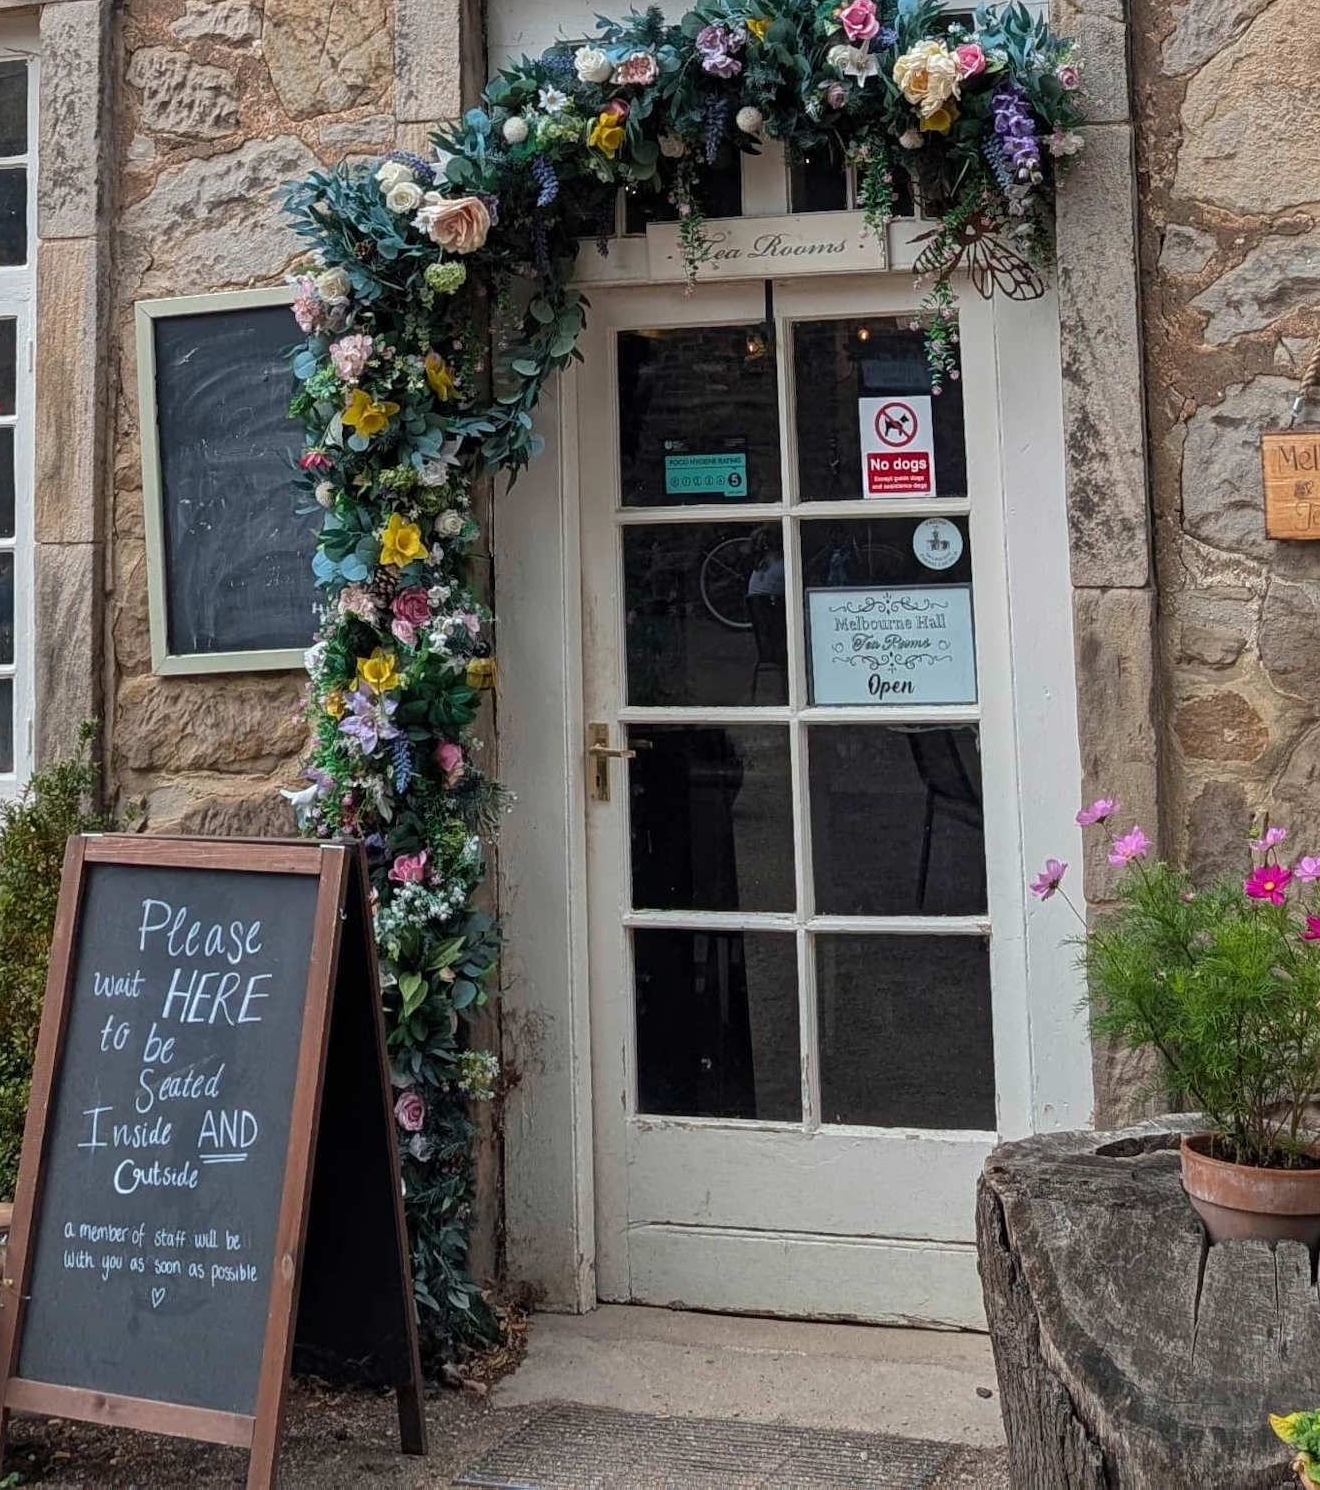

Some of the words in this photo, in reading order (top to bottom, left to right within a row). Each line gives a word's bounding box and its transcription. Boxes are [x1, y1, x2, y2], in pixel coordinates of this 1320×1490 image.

[696, 232, 742, 261] Tea
[747, 232, 848, 259] Rooms
[729, 473, 740, 486] 5
[870, 458, 890, 471] No
[893, 456, 927, 473] dogs
[835, 615, 912, 631] Melbourne
[916, 613, 946, 629] Hall
[852, 633, 880, 651] Tea
[882, 634, 932, 651] Rooms
[868, 673, 916, 700] Open
[138, 898, 262, 964] Please
[162, 968, 272, 1026] HERE
[100, 1014, 131, 1052] to
[143, 1022, 175, 1063] be
[135, 1063, 226, 1113] Seated
[77, 1106, 172, 1150] Inside
[197, 1110, 258, 1148] AND
[113, 1159, 198, 1194] Outside
[64, 1221, 76, 1238] a
[79, 1222, 128, 1243] member
[131, 1222, 145, 1248] of
[154, 1228, 186, 1248] staff
[194, 1229, 218, 1248] will
[225, 1231, 241, 1250] be
[101, 1254, 123, 1281] you
[129, 1256, 145, 1273] as
[154, 1257, 181, 1275] soon
[188, 1261, 205, 1279] as
[211, 1263, 258, 1288] possible
